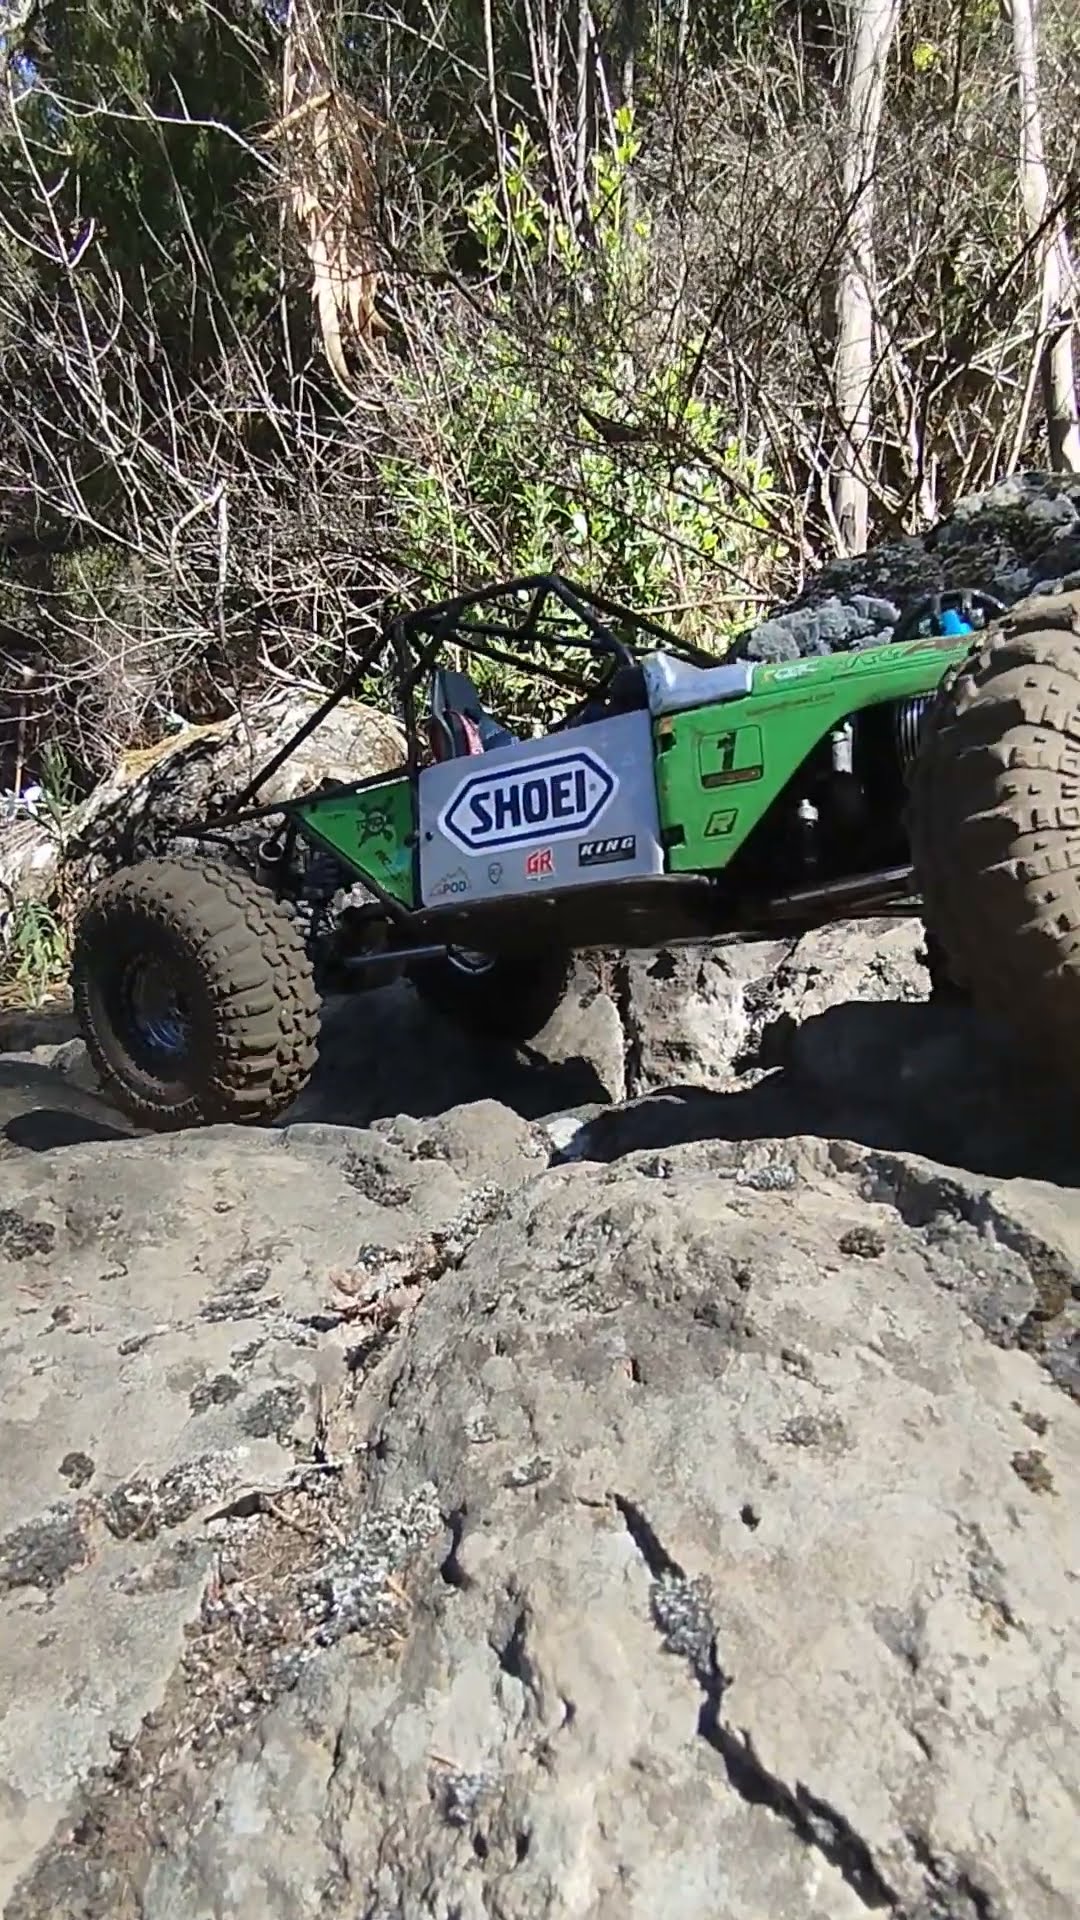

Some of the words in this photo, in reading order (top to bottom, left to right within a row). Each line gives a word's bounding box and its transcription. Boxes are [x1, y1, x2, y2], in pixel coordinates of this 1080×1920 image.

[716, 731, 737, 770] 1
[470, 769, 587, 836] SHOEI
[527, 850, 552, 874] GR
[581, 836, 634, 857] KING
